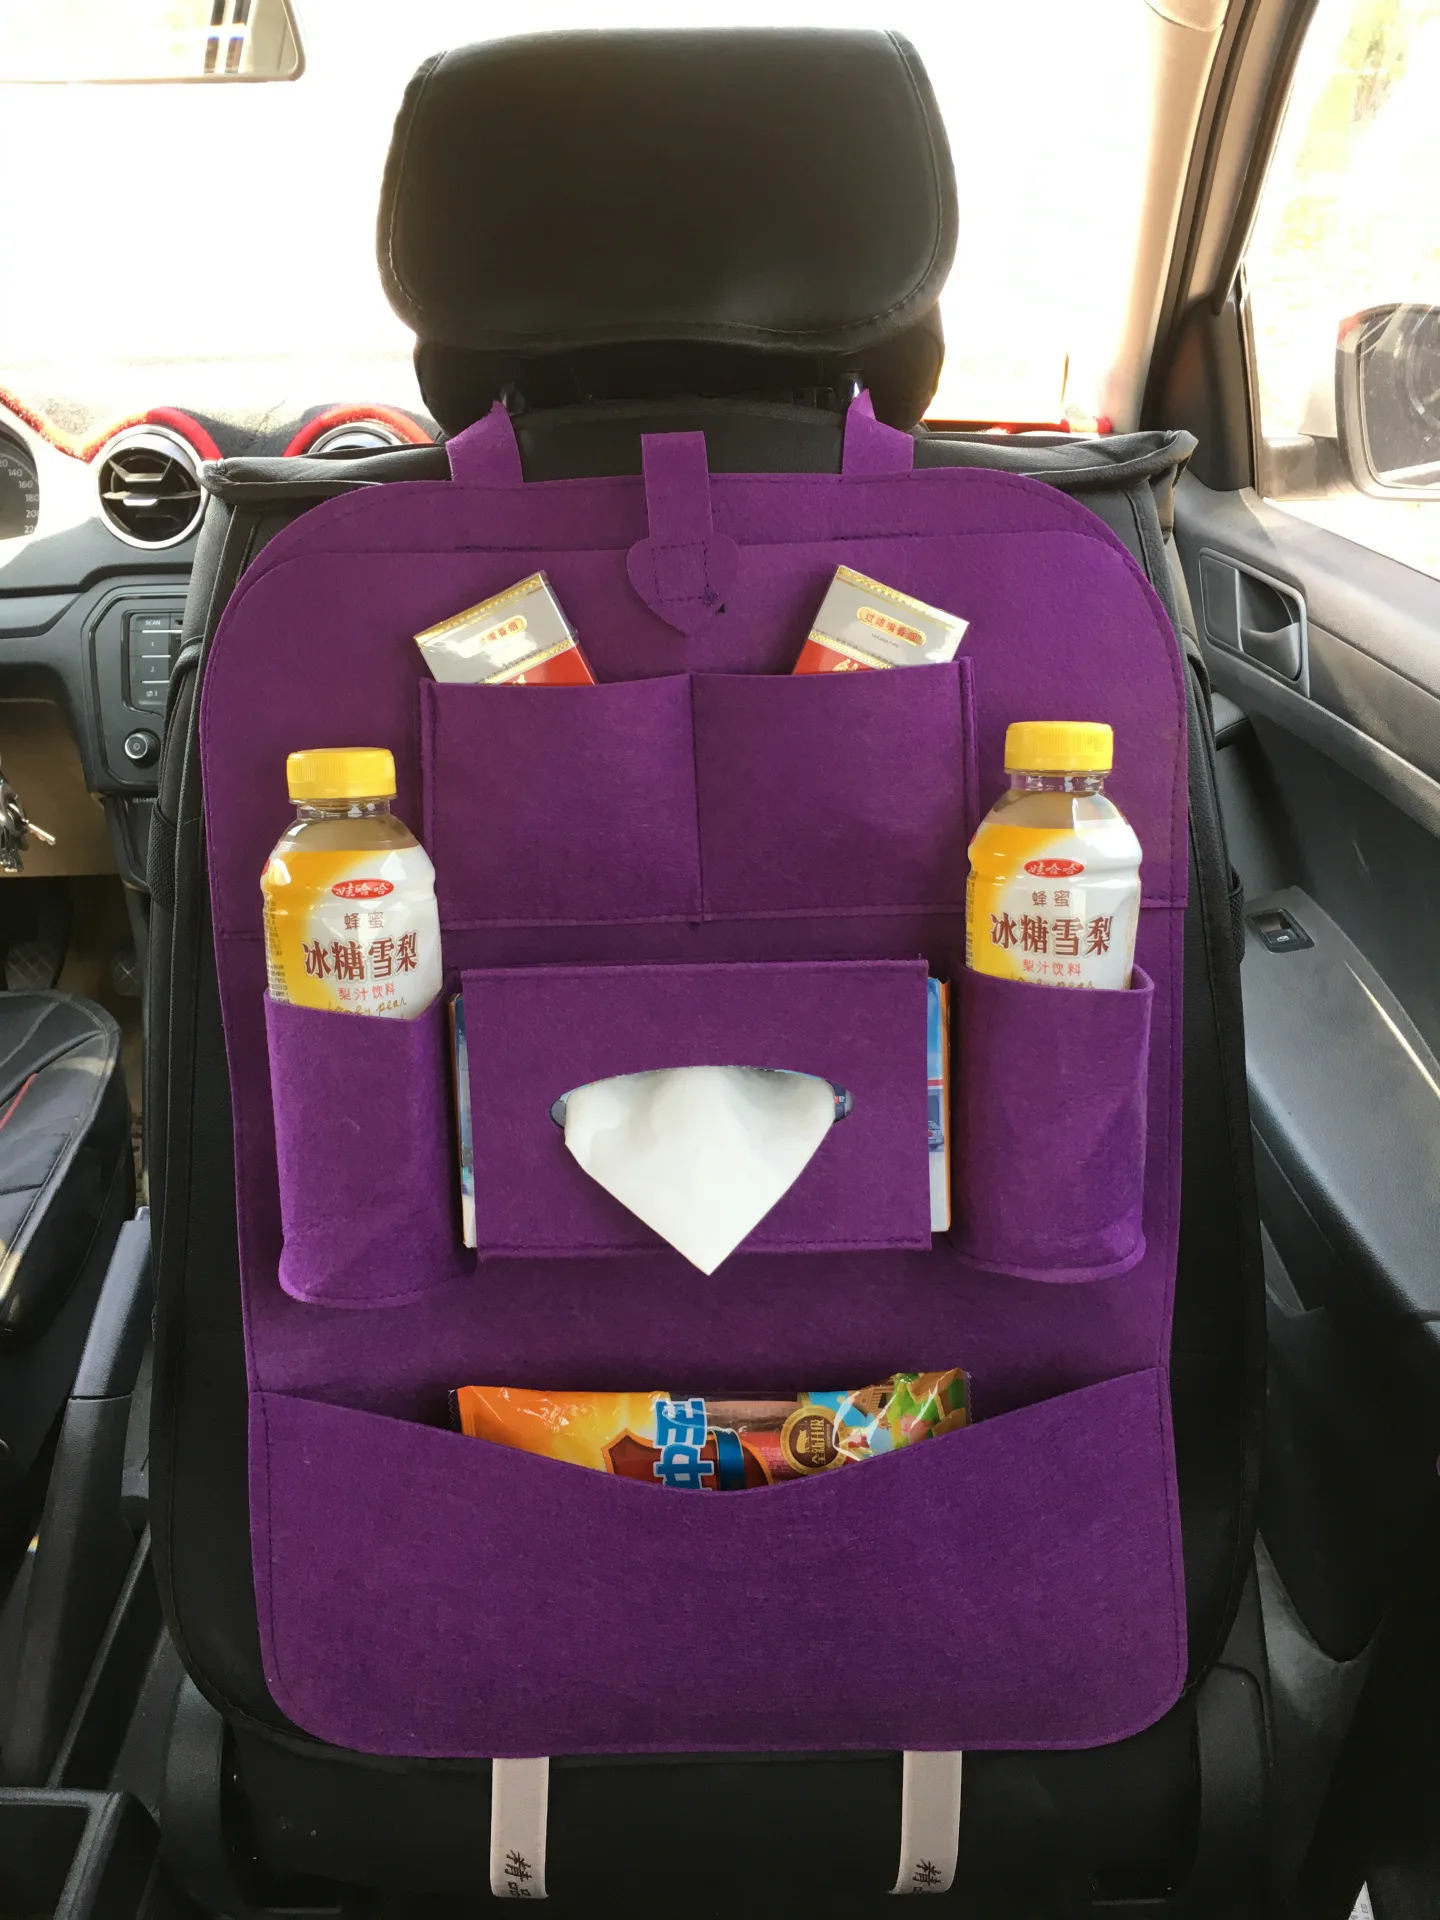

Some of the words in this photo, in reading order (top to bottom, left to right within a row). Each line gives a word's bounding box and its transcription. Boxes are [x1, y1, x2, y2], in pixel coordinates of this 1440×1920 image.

[8, 469, 23, 477] 140
[19, 480, 33, 488] 160
[25, 494, 39, 502] 180
[1028, 861, 1079, 875] 娃哈哈
[335, 882, 389, 897] 娃哈哈
[1031, 889, 1070, 907] 蜂蜜
[344, 911, 384, 931] 蜂蜜
[990, 912, 1113, 957] 冰糖雪梨
[301, 931, 420, 981] 冰糖雪梨
[810, 1419, 826, 1464] 全新升级
